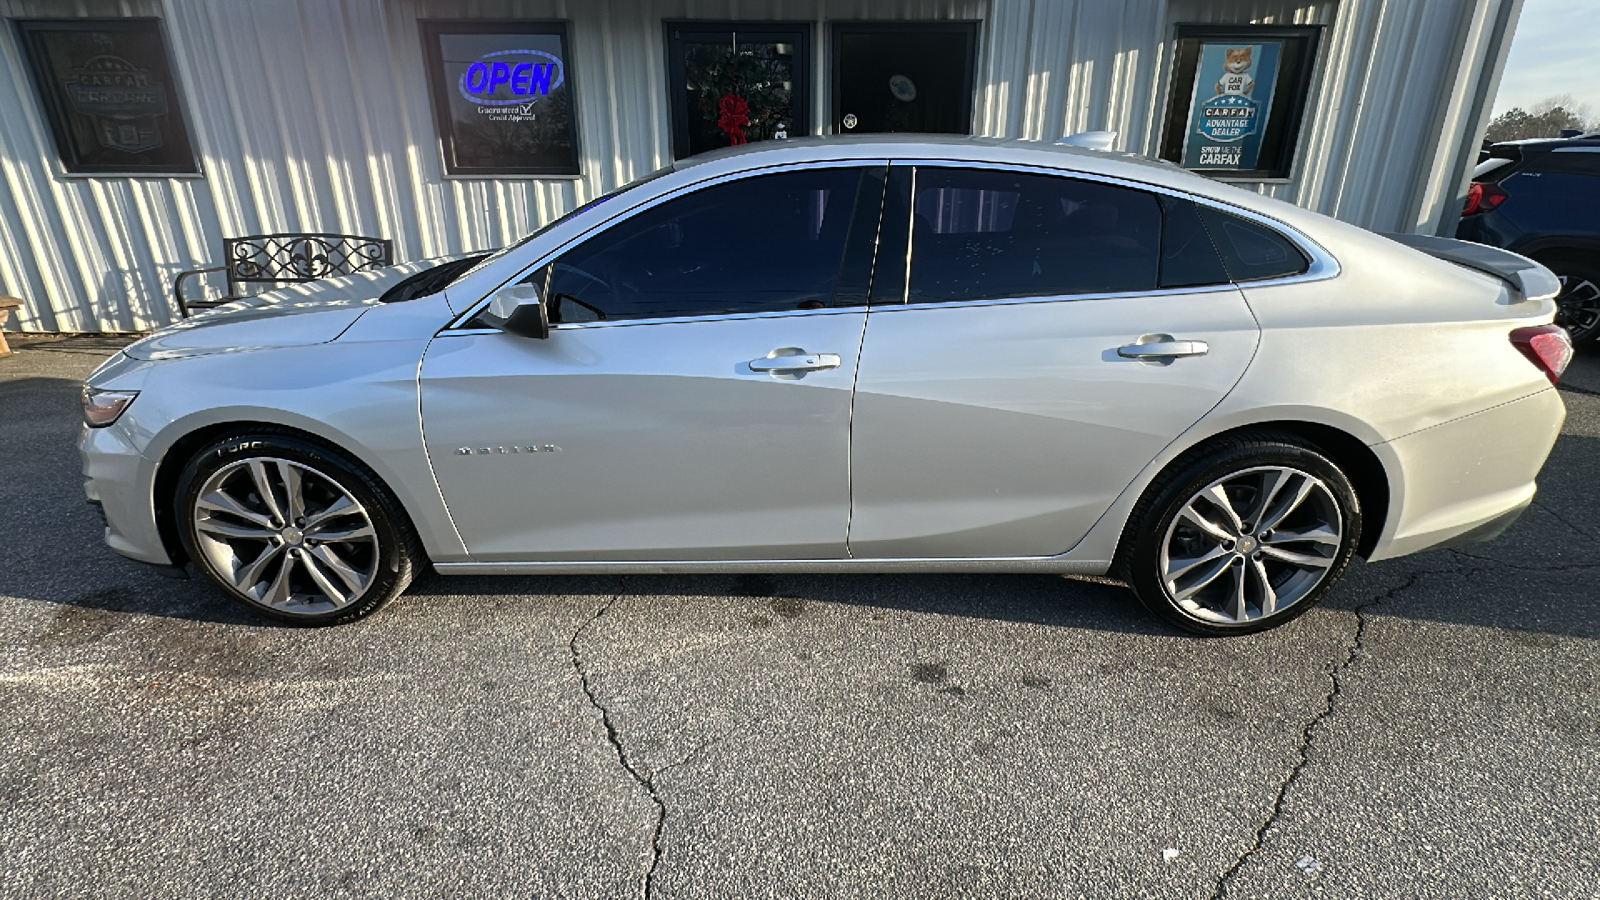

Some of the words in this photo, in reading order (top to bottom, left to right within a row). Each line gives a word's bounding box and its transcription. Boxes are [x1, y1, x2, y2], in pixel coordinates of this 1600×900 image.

[465, 61, 554, 95] OPEN
[477, 106, 519, 114] Guaranteed
[1205, 107, 1254, 118] CARFAX
[508, 114, 536, 123] Approved
[1205, 119, 1249, 127] ADVANTAGE
[1211, 128, 1241, 136] DEALER
[1201, 146, 1221, 154] SHOW
[1221, 146, 1231, 154] ME
[1231, 146, 1243, 154] THE
[1200, 154, 1241, 165] CARFAX
